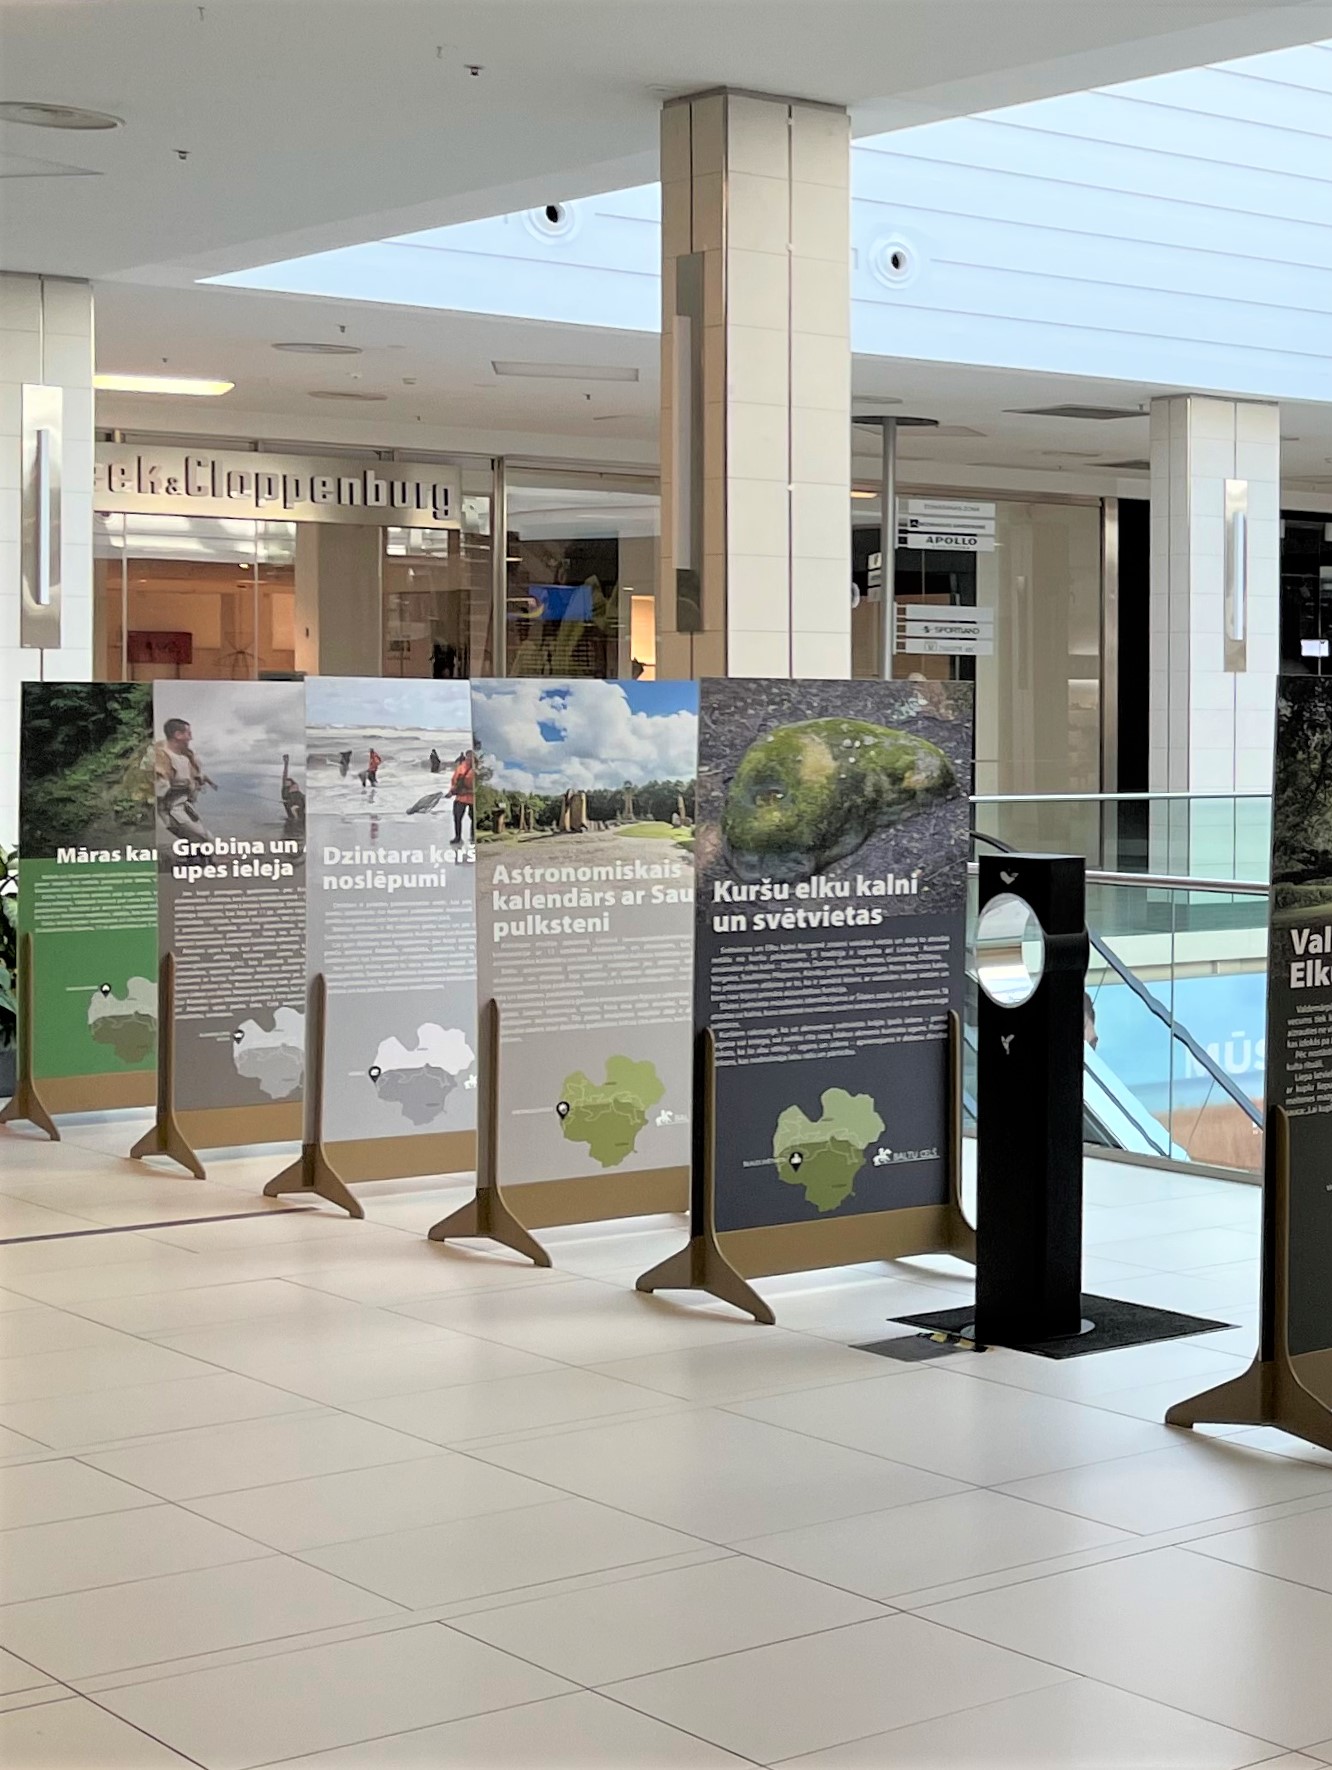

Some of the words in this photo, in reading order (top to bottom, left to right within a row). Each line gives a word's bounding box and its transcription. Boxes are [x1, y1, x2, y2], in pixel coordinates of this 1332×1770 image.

[926, 536, 977, 545] APOLLO
[57, 845, 121, 864] Māras
[172, 837, 265, 860] Grobiņa
[270, 839, 298, 854] un
[322, 846, 423, 866] Dzintara
[172, 864, 228, 883] upes
[232, 859, 293, 880] ieleja
[322, 868, 446, 893] noslēpumi
[492, 858, 681, 885] Astronomiskais
[492, 887, 616, 913] kalendārs
[621, 890, 646, 905] ar
[712, 878, 789, 903] Kuršu
[795, 875, 849, 899] elku
[856, 872, 918, 896] kalni
[493, 911, 610, 942] pulksteni
[713, 915, 747, 933] un
[752, 905, 883, 930] svētvietas
